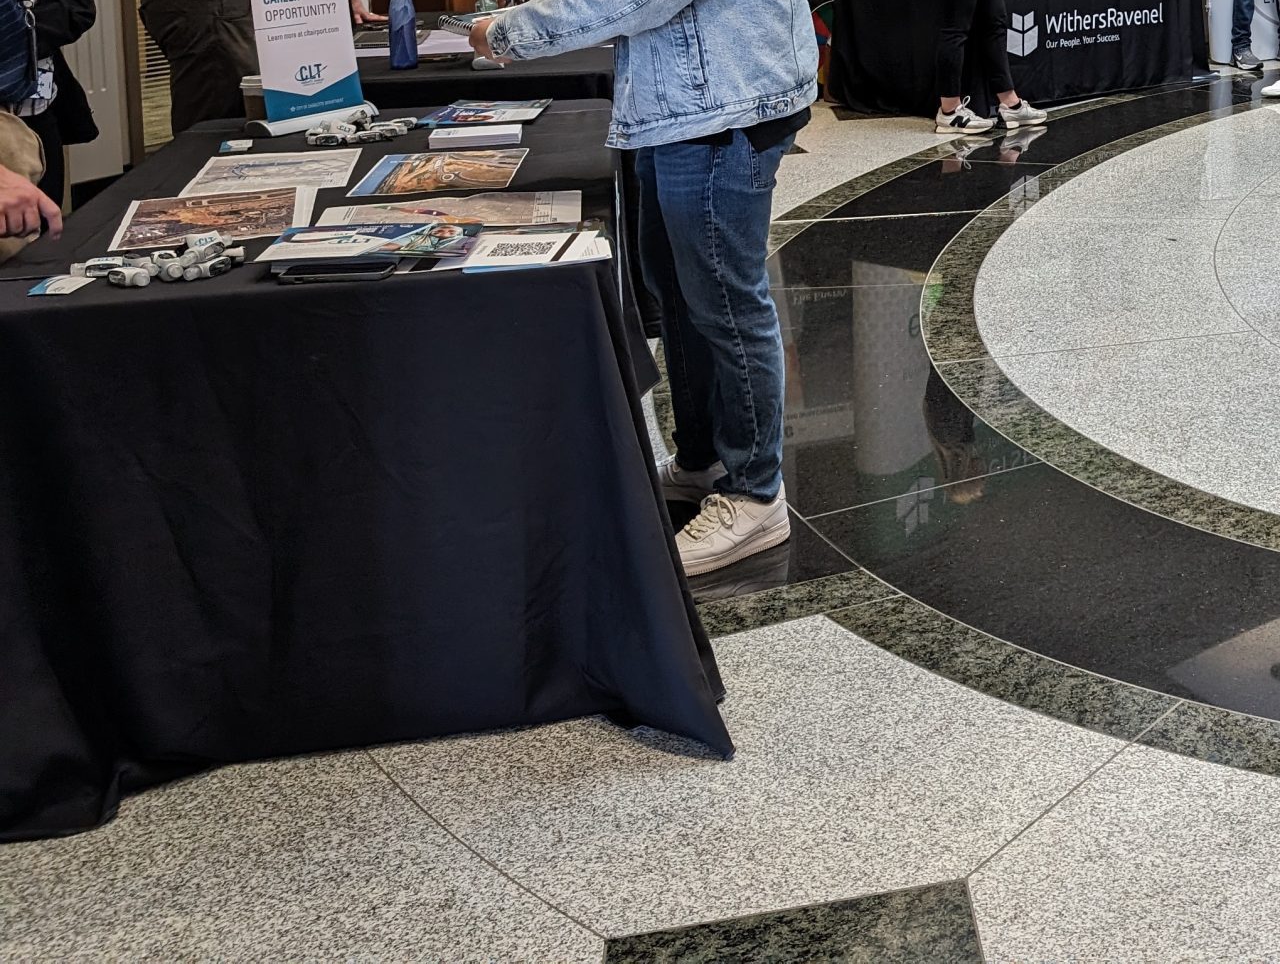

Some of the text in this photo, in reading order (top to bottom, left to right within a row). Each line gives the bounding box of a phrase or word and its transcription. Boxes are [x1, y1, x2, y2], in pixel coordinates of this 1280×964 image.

[265, 2, 337, 22] OPPORTUNITY?
[1045, 2, 1164, 34] WithersRavenel
[267, 33, 283, 42] Learn
[284, 32, 297, 40] more
[1045, 39, 1059, 49] Our
[1059, 37, 1082, 49] People.
[1082, 35, 1096, 44] Your
[298, 63, 323, 82] CLT
